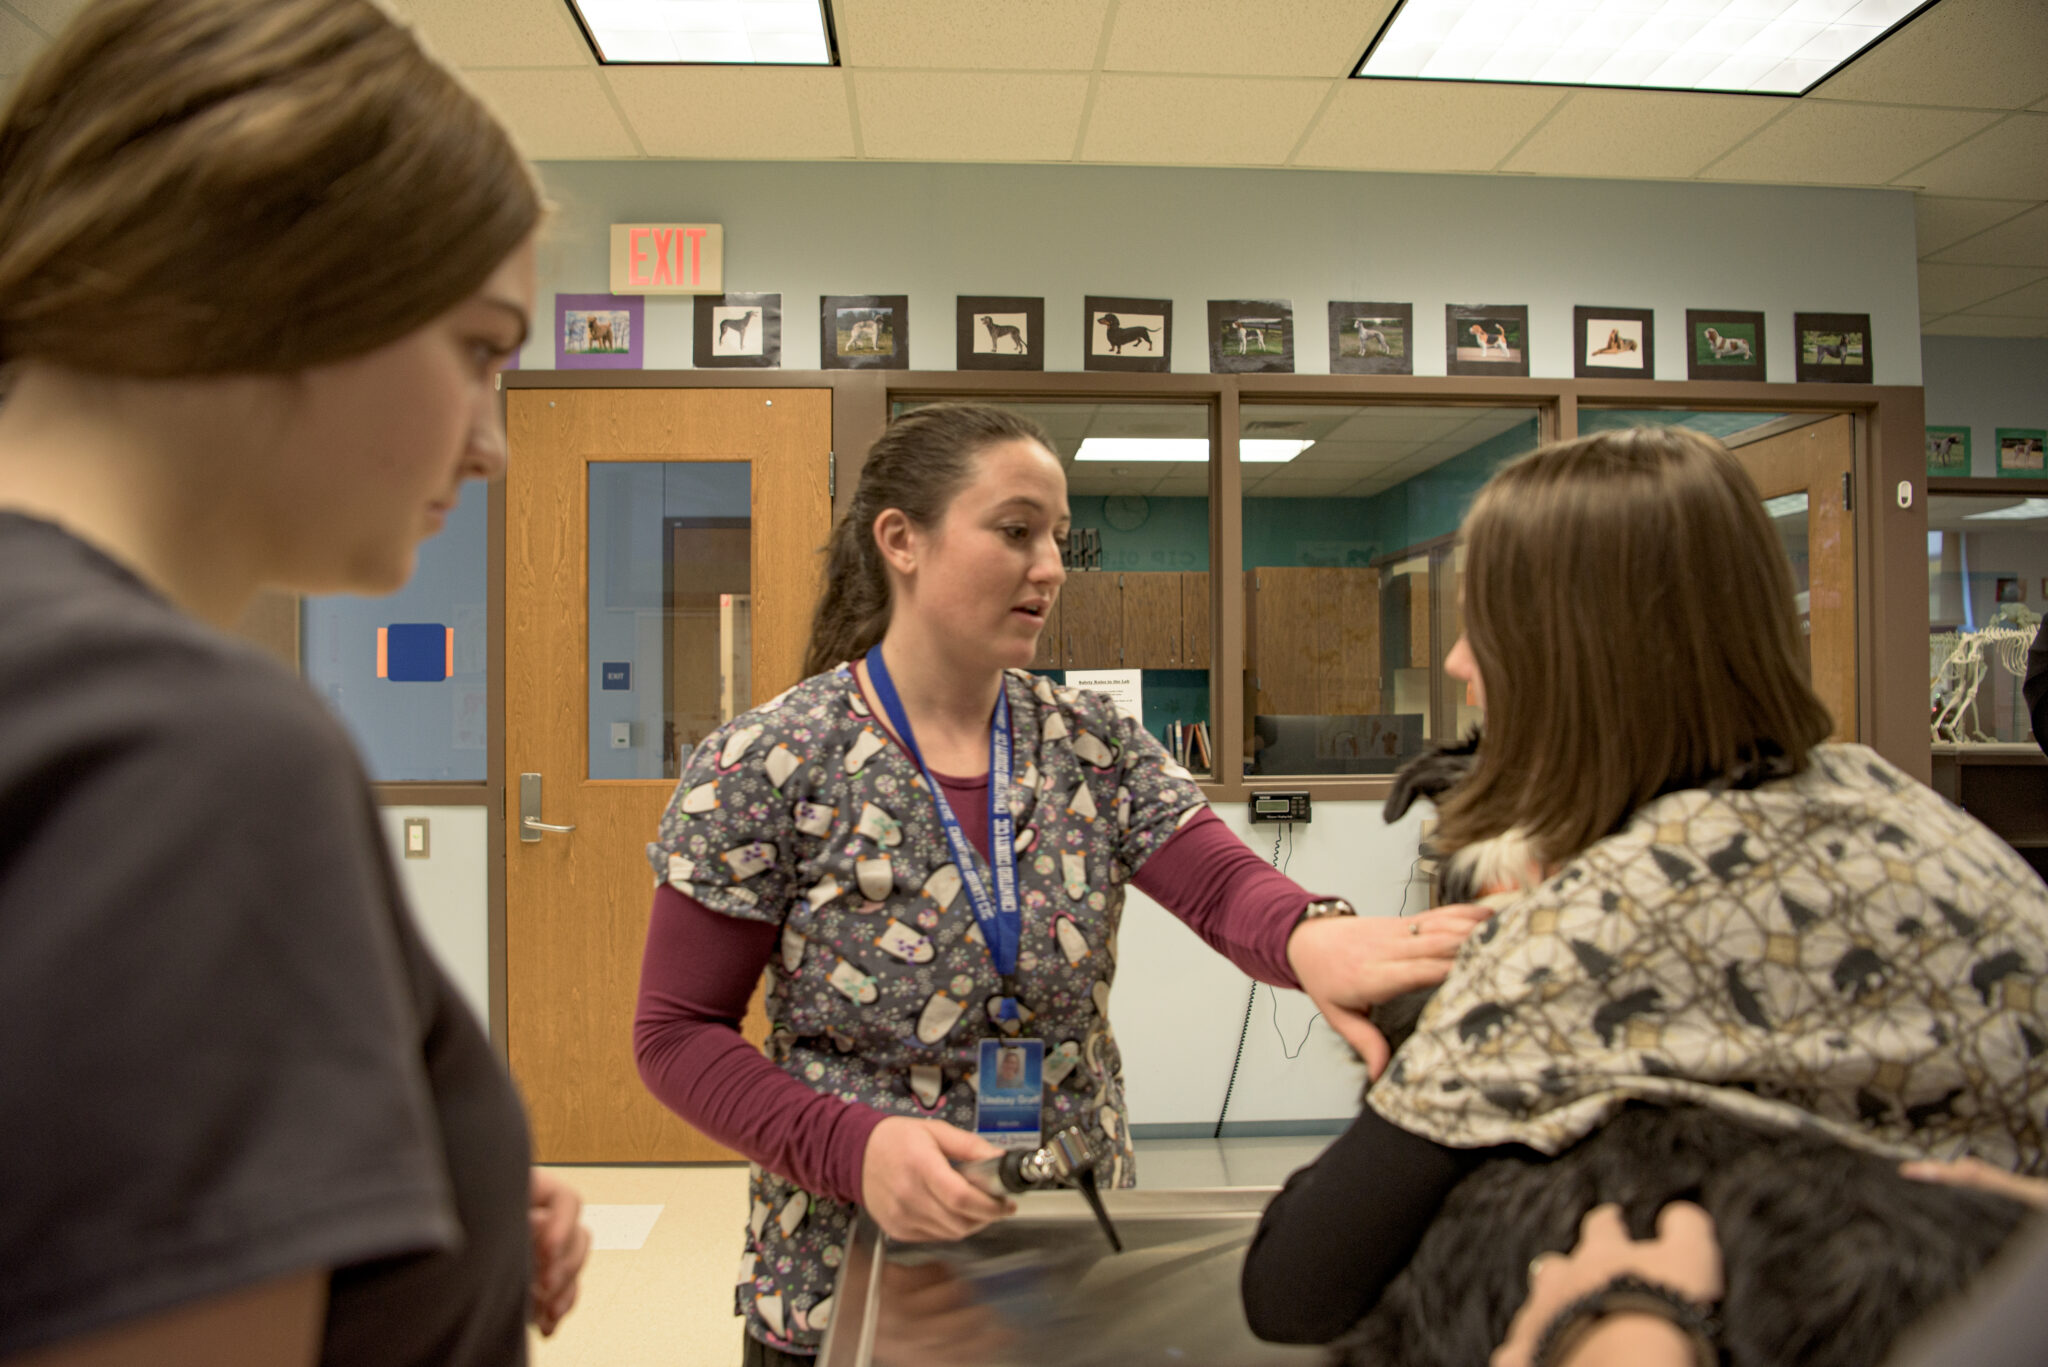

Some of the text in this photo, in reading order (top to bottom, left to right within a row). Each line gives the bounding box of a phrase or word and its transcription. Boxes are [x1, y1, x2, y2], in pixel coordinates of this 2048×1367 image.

[629, 228, 707, 286] EXIT
[607, 671, 624, 680] EXIT
[993, 818, 1018, 912] CRAWFORD COUNTY CTC
